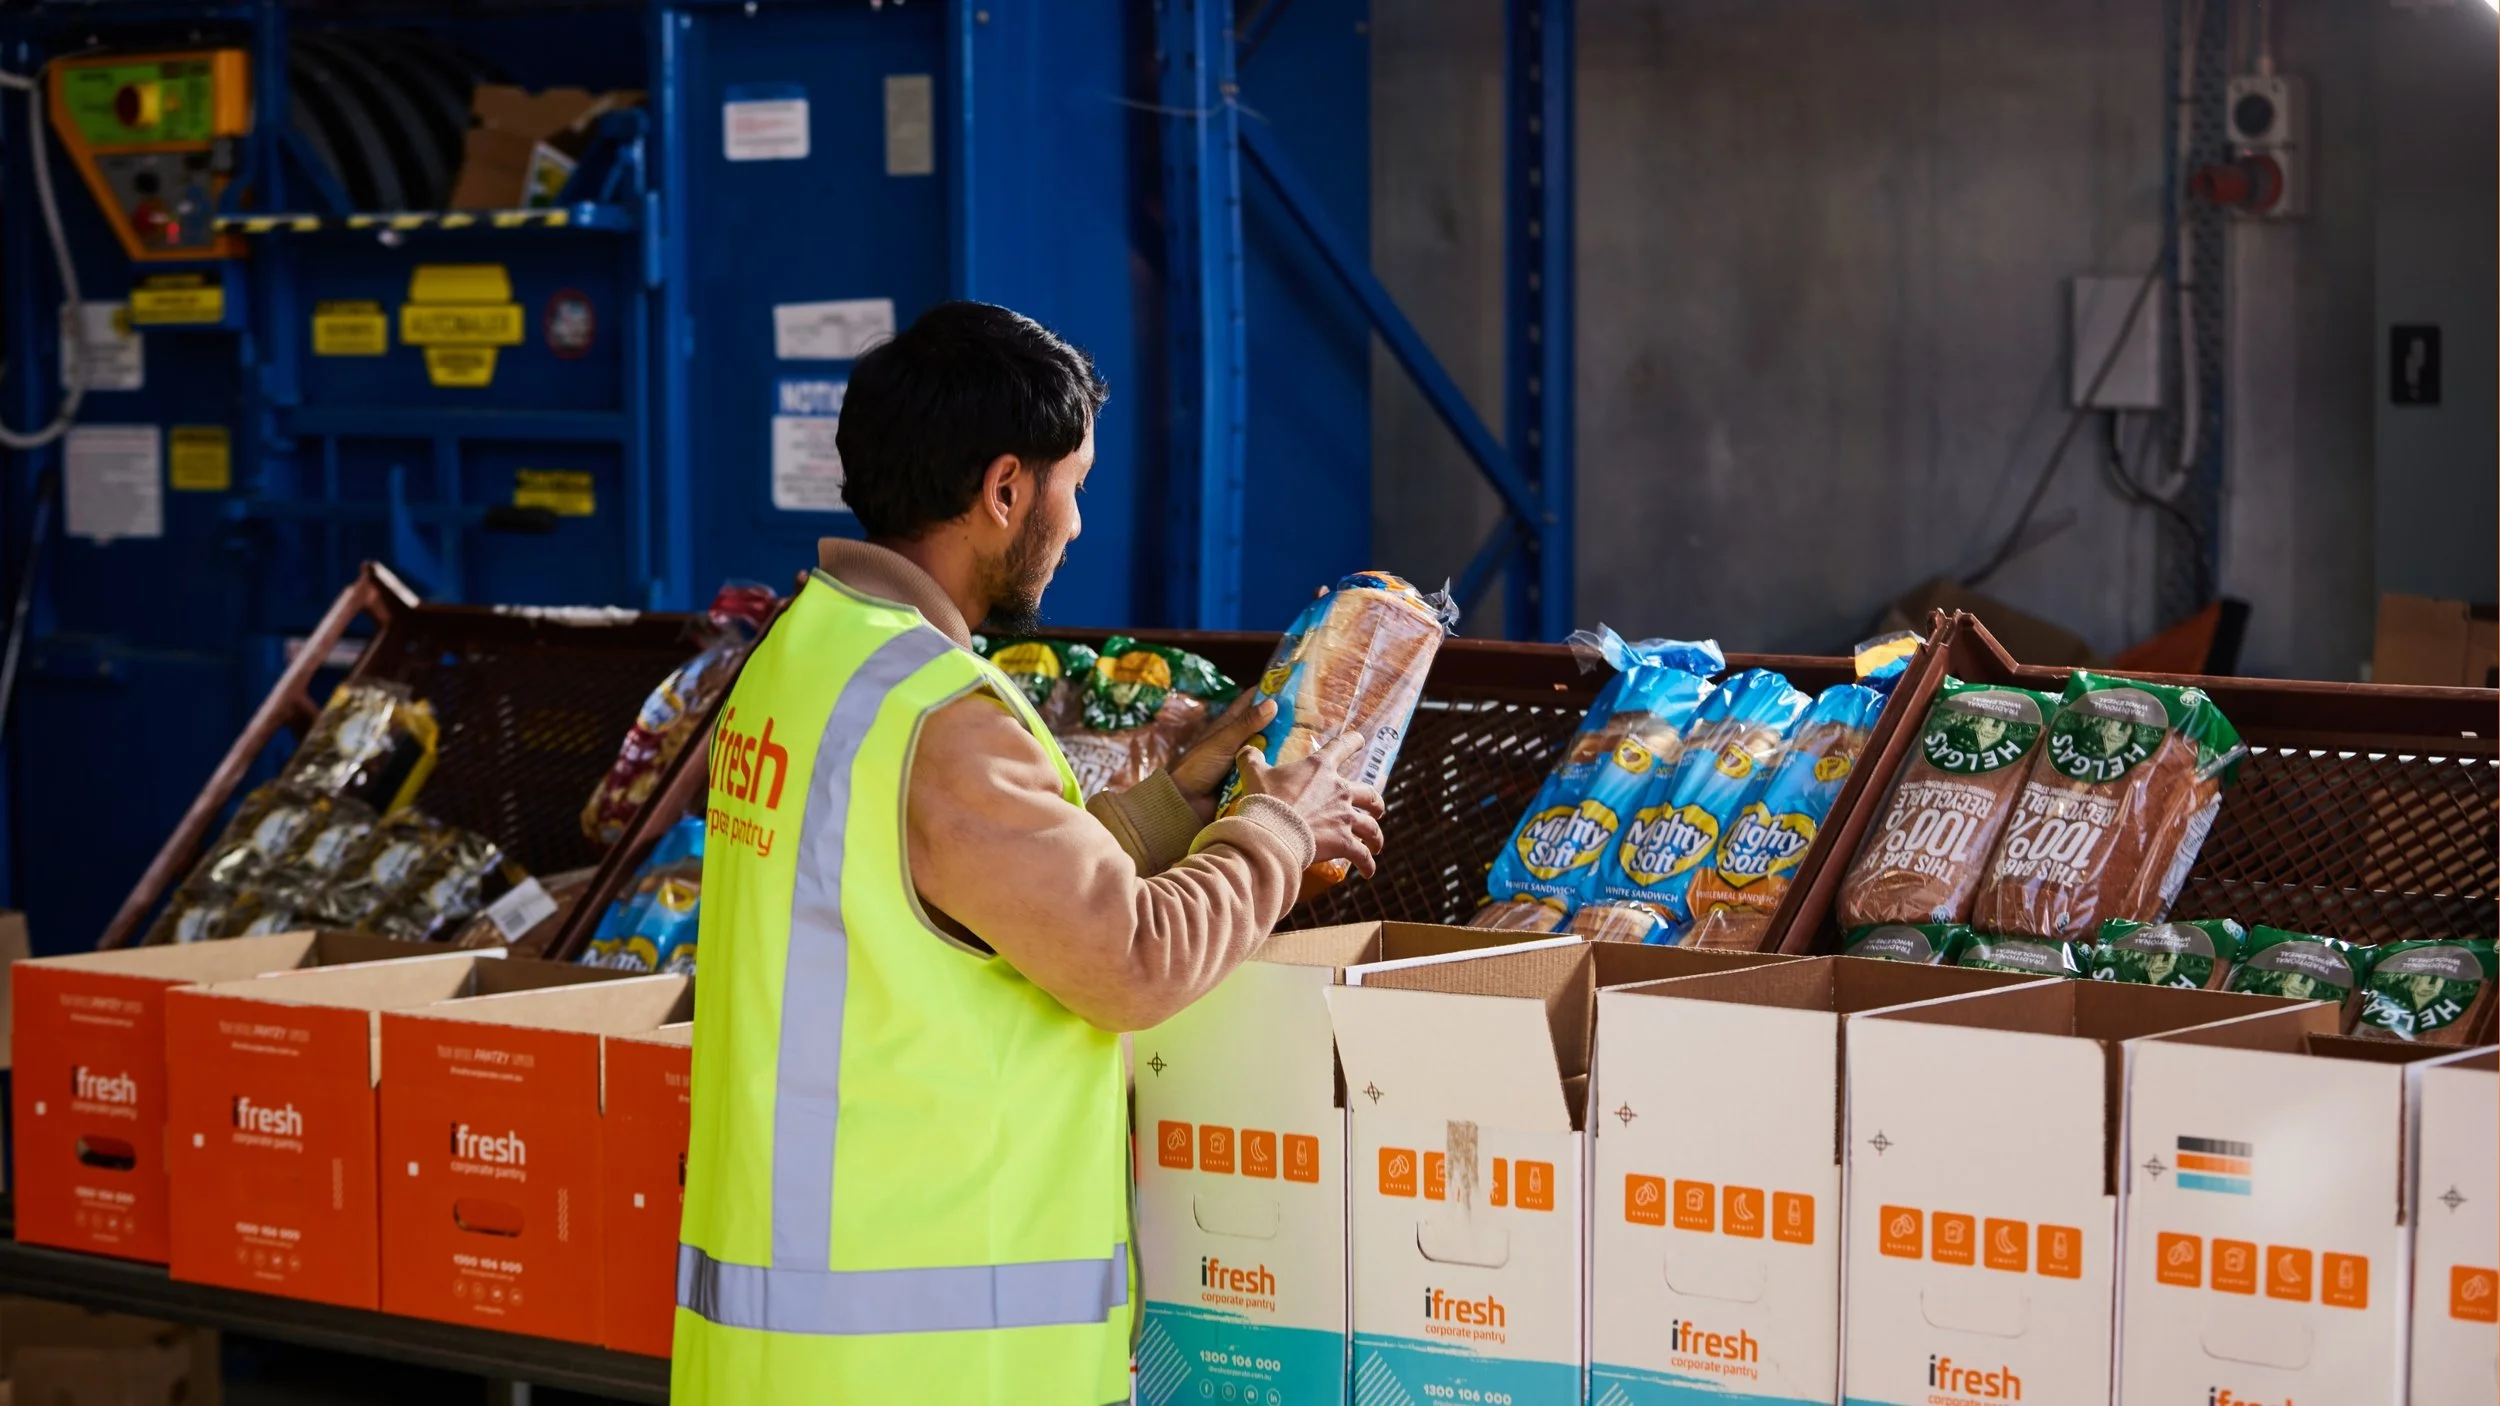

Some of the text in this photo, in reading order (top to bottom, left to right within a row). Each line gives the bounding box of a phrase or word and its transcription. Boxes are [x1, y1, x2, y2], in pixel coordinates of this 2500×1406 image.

[781, 382, 848, 411] NOTI
[1967, 700, 2018, 716] TRADITIONAL
[1925, 732, 2022, 771] HELGA'S
[2052, 733, 2147, 780] HELGA'S
[1894, 788, 1993, 820] RECYCLABLE
[1627, 813, 1711, 857] Mghty
[1884, 806, 1978, 862] 100%
[2006, 808, 2103, 870] 100%
[1529, 841, 1577, 869] Soft
[1631, 846, 1676, 875] Soft
[1722, 843, 1770, 874] Soft
[1914, 854, 1956, 885] THIS
[1531, 881, 1576, 896] SANDWICH
[2037, 858, 2079, 888] THIS
[1605, 885, 1679, 904] WHITE SANDWICH
[72, 1065, 136, 1105] ifresh
[232, 1095, 302, 1136] ifresh
[451, 1121, 526, 1166] ifresh
[450, 1161, 527, 1183] corporate pantry
[1201, 1255, 1275, 1297] ifresh
[1201, 1291, 1276, 1313] corporate pantry
[1425, 1286, 1506, 1328] ifresh
[1425, 1323, 1506, 1345] corporate pantry
[1672, 1318, 1759, 1363] ifresh
[1200, 1349, 1282, 1373] 1300 106 000
[1671, 1356, 1758, 1381] corporate pantry
[1928, 1353, 2022, 1402] ifresh
[1423, 1383, 1512, 1406] 1300 106 000
